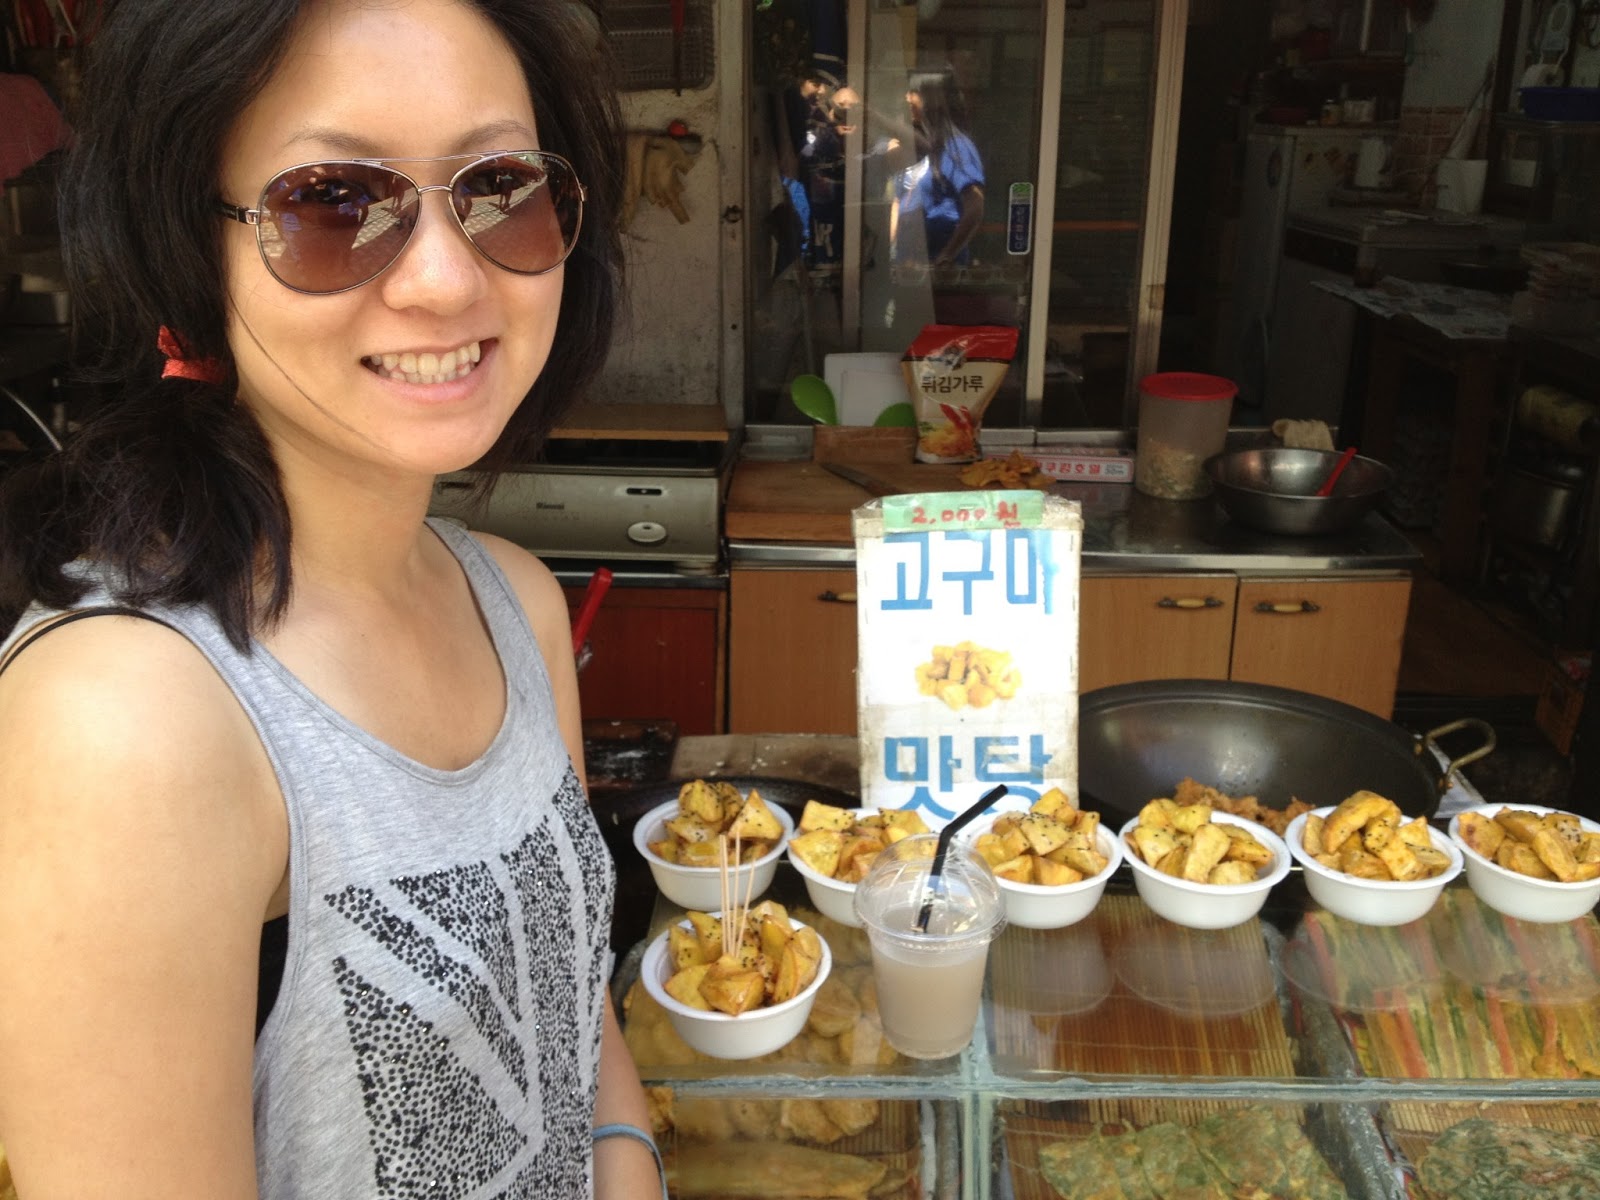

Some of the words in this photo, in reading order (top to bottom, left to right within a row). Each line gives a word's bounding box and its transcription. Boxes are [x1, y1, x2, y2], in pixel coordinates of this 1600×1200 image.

[921, 375, 984, 393] 튀김가루
[881, 527, 1059, 615] 고구마
[884, 734, 1053, 820] 맛탕
